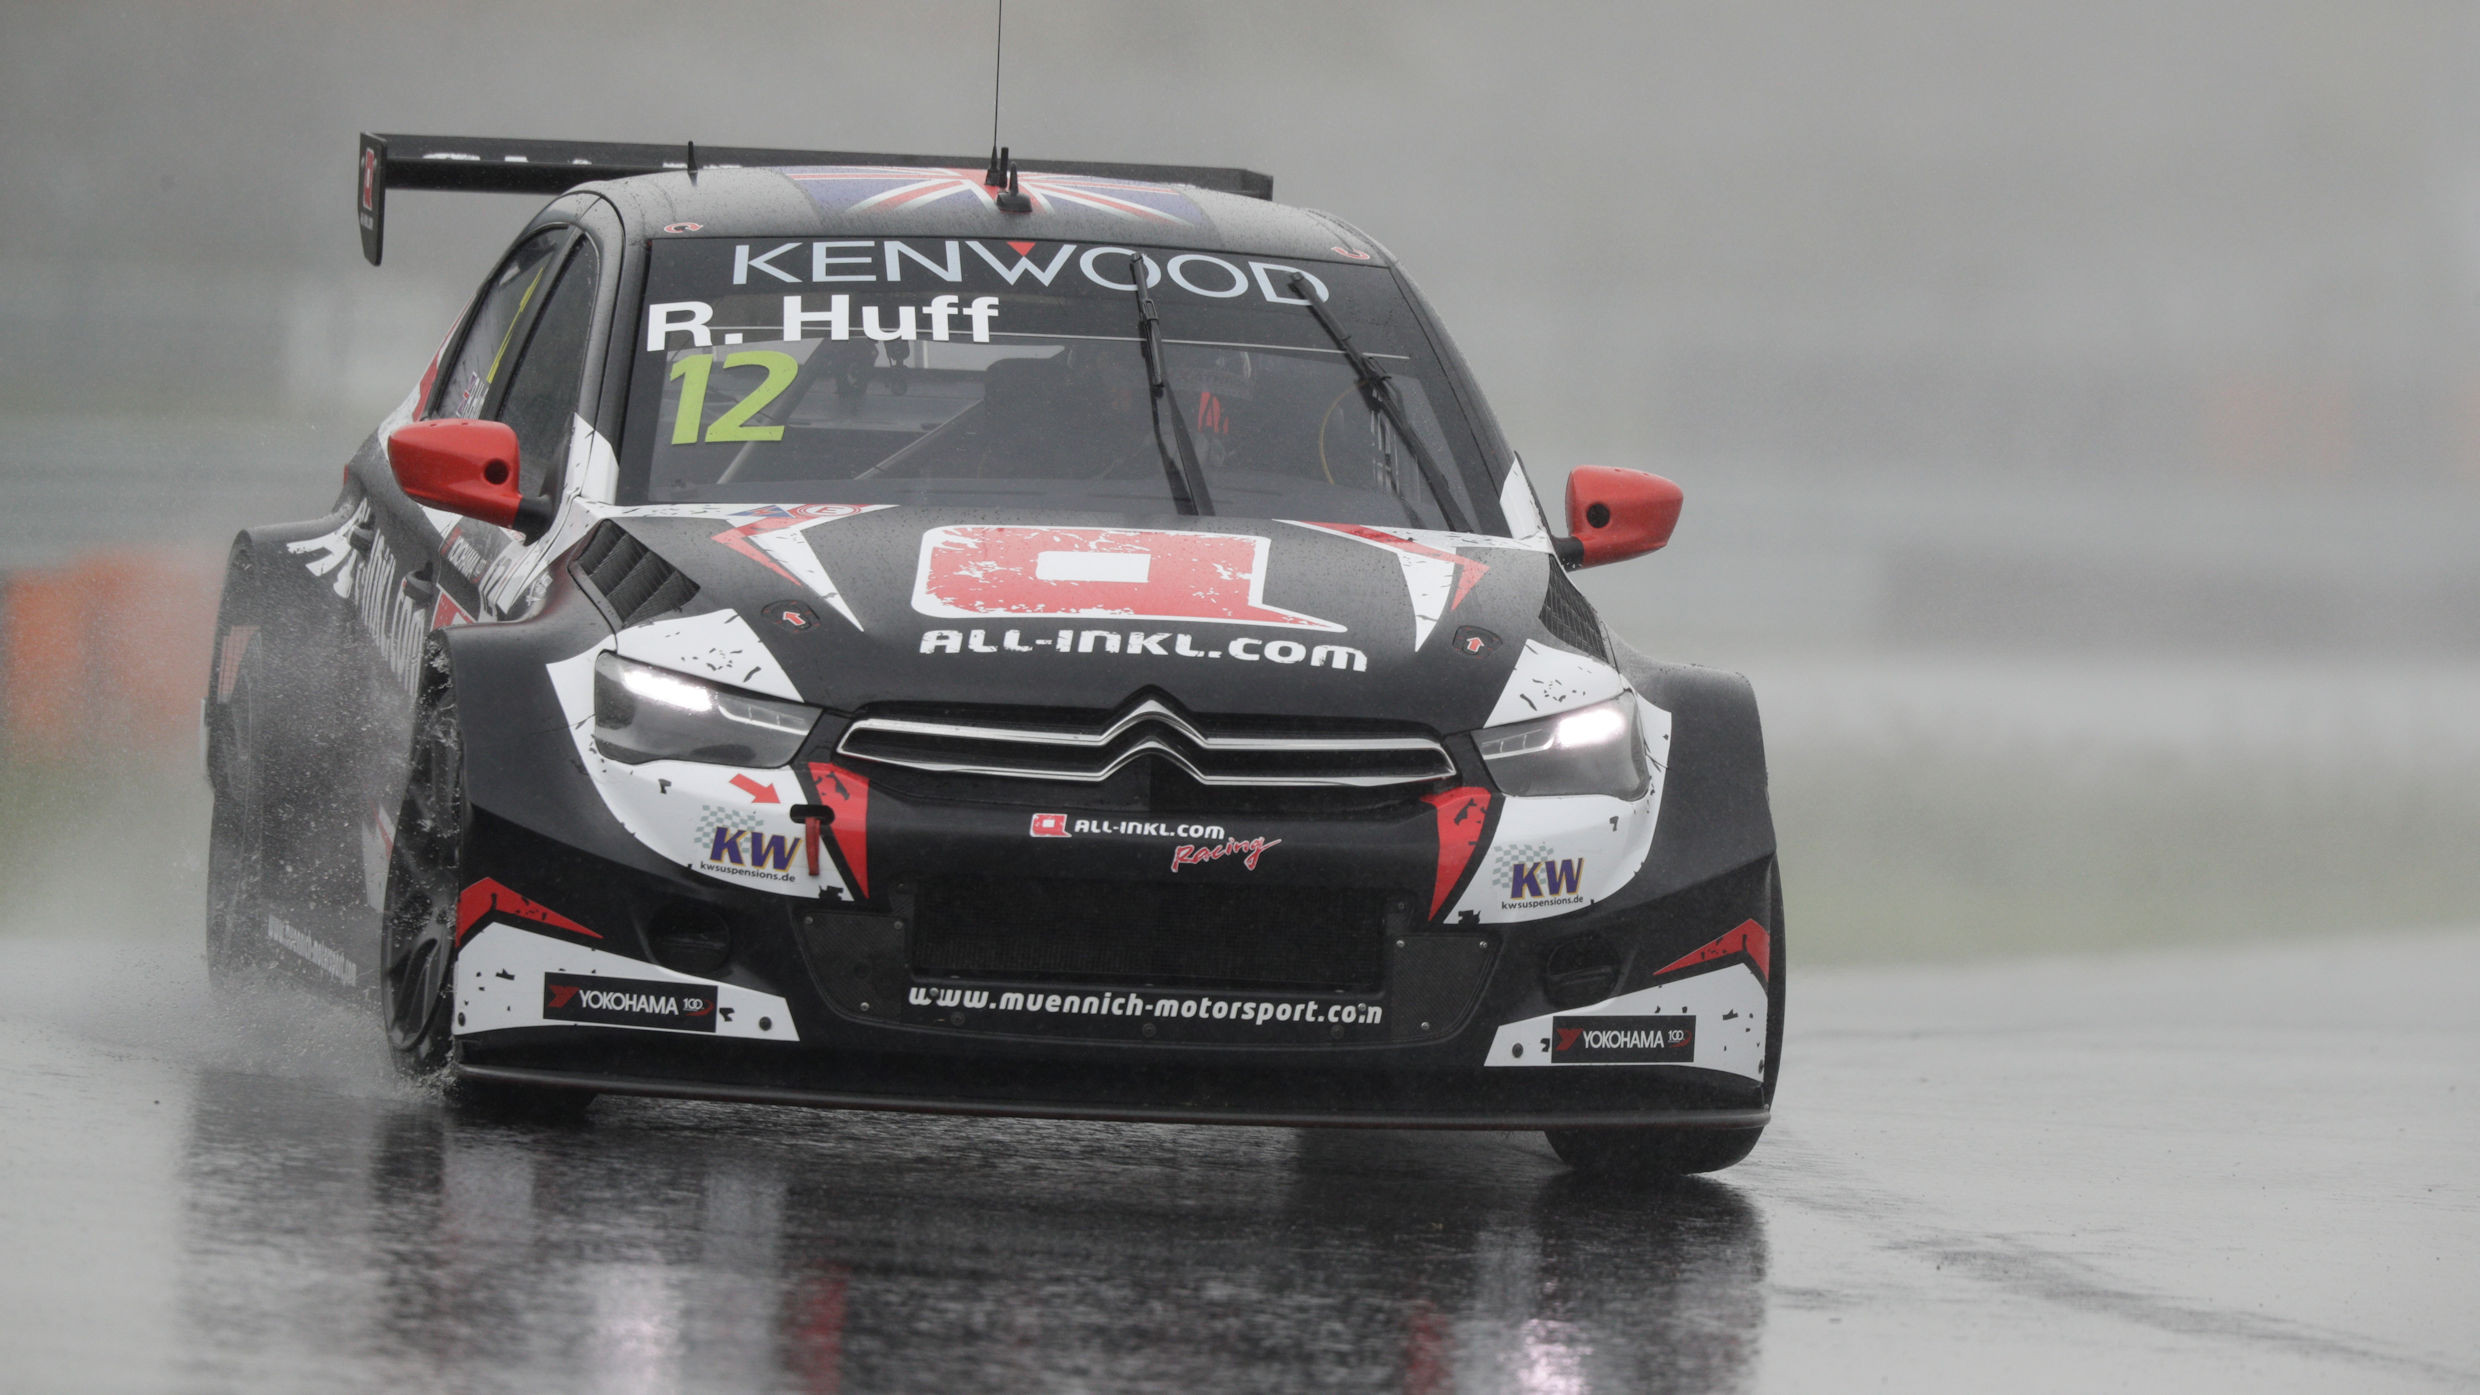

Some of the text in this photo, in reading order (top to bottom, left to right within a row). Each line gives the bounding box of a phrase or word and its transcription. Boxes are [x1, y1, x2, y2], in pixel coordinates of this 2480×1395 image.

[733, 241, 1330, 306] KENWOOD
[647, 294, 999, 351] R. Huff
[670, 350, 799, 445] 12
[710, 826, 803, 873] KW
[1171, 836, 1282, 872] Racing
[700, 861, 797, 883] kwsuspensions.de
[1510, 857, 1584, 900] KW
[1501, 895, 1584, 910] kwsuspensions.de
[579, 989, 679, 1016] YOKOHAMA
[908, 987, 1383, 1025] www.muennich-motorsport.com
[1583, 1030, 1665, 1049] YOKOHAMA
